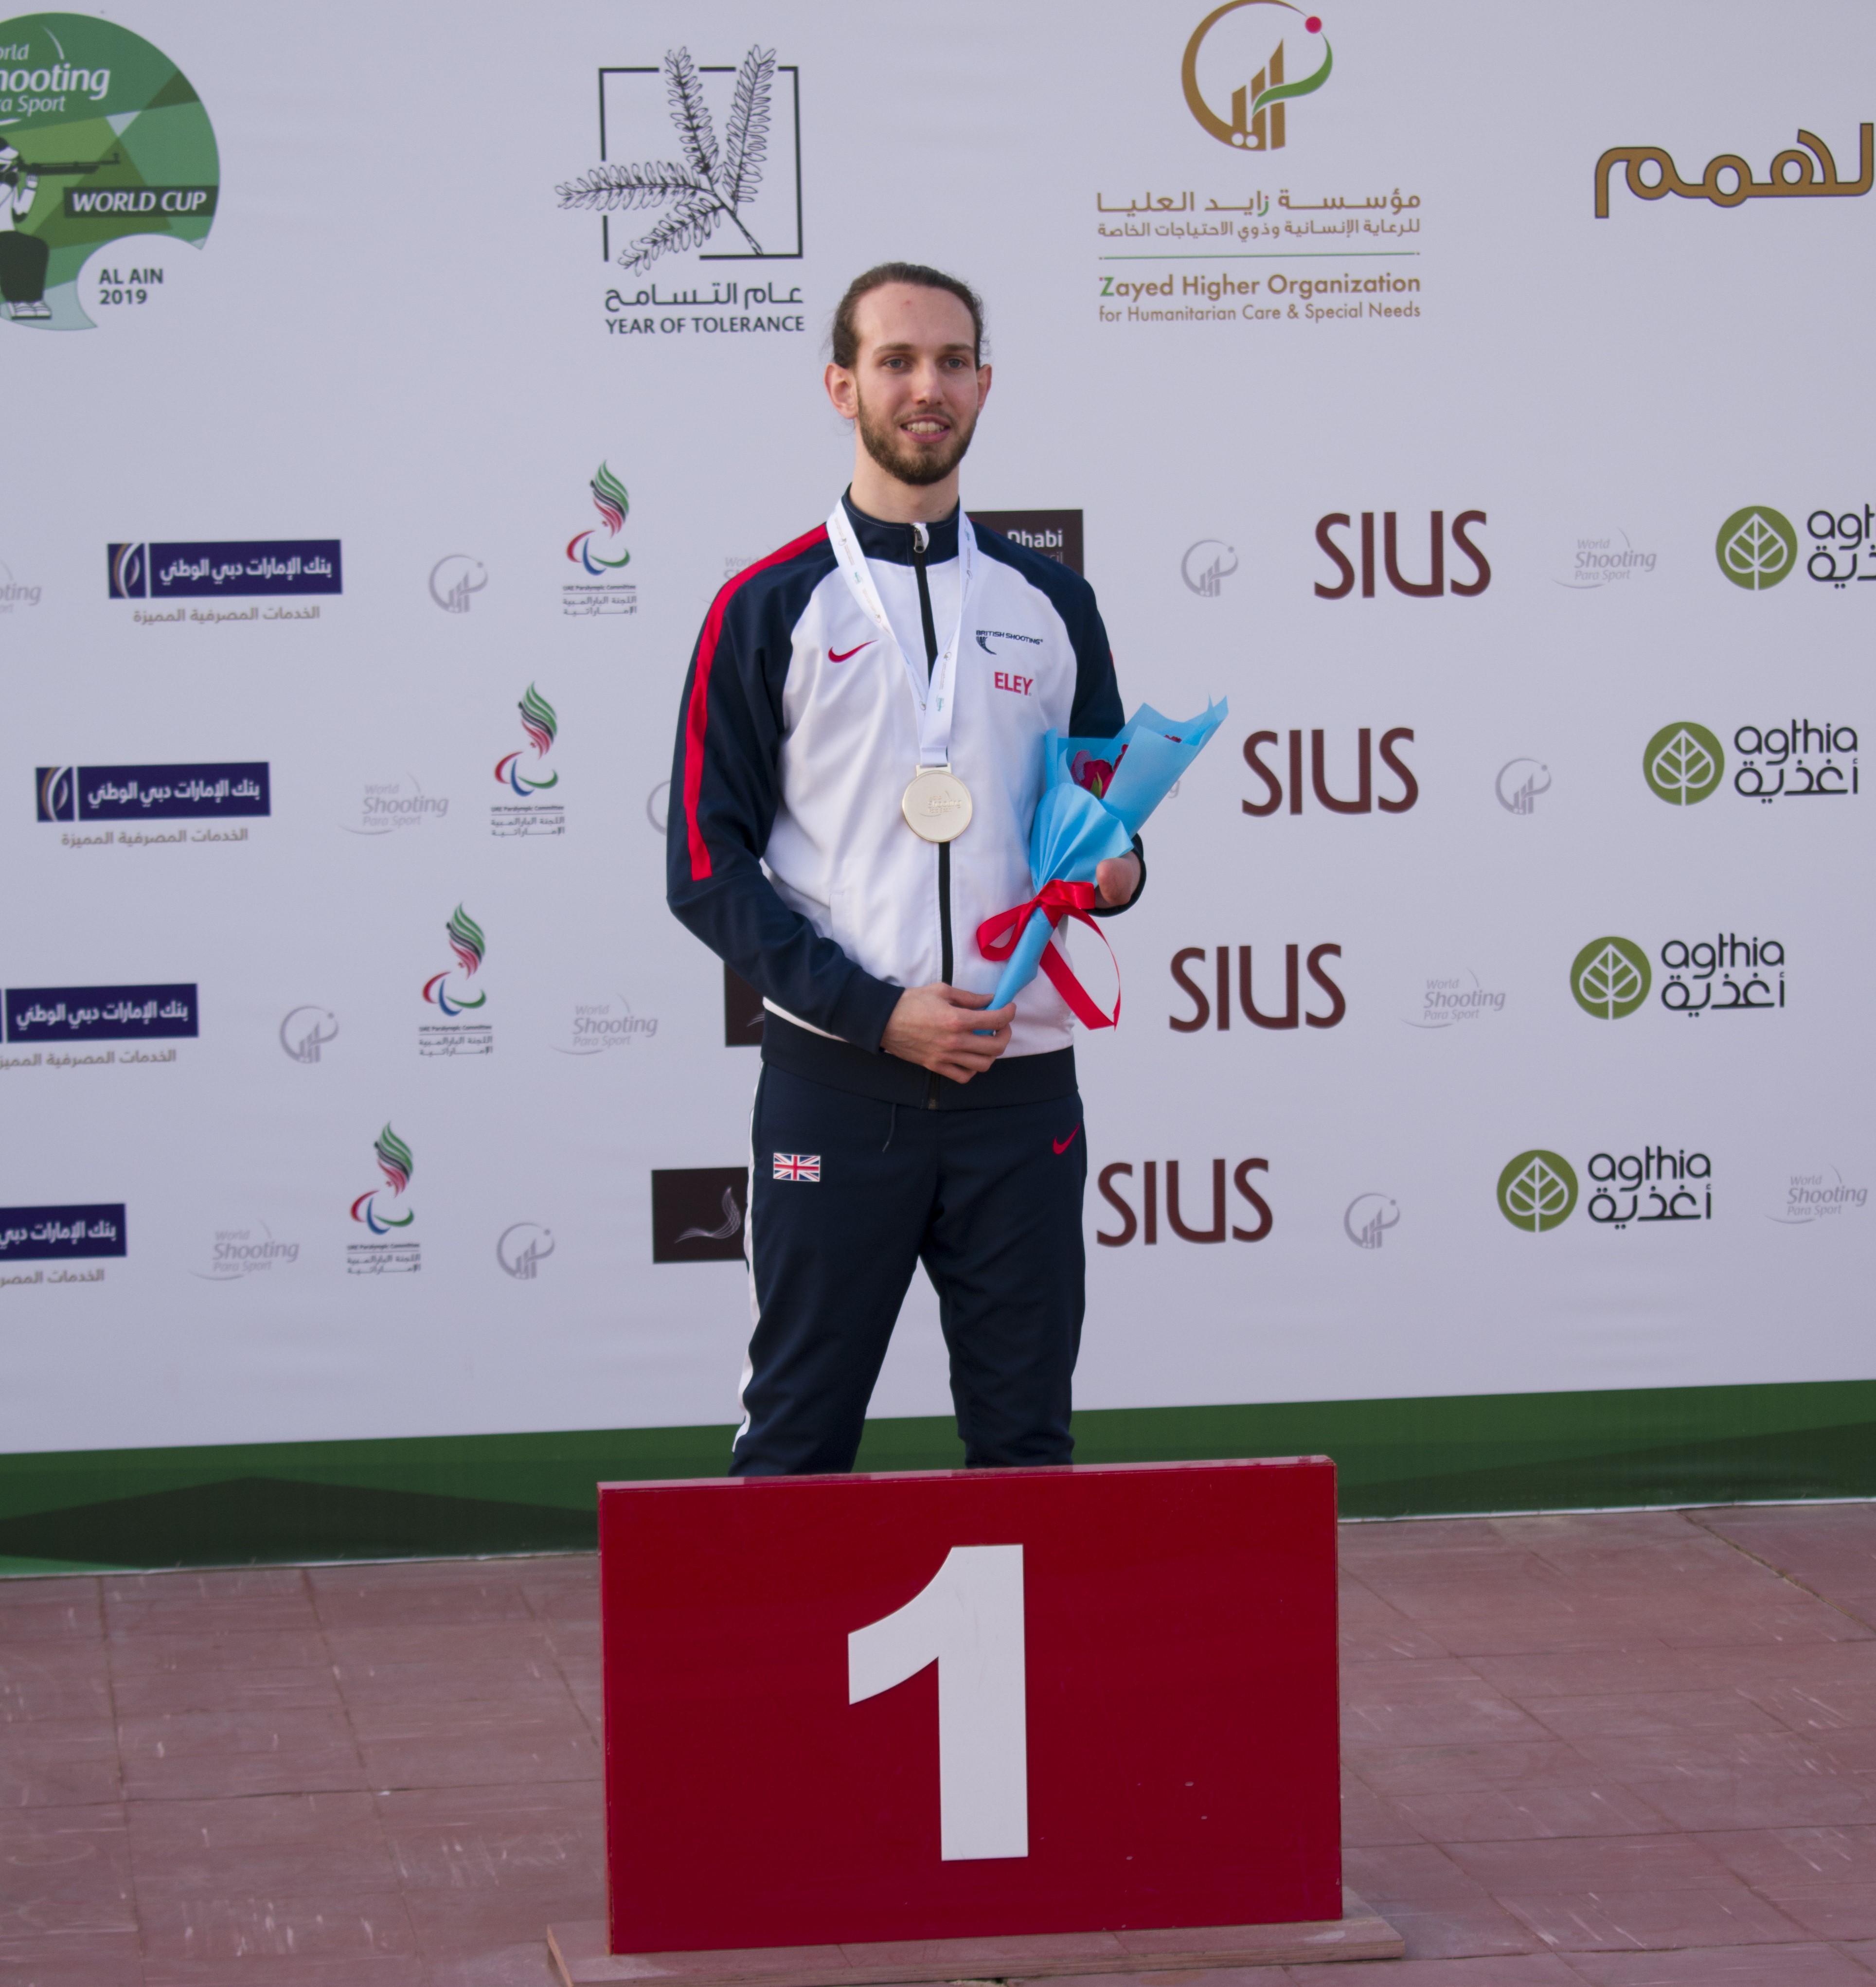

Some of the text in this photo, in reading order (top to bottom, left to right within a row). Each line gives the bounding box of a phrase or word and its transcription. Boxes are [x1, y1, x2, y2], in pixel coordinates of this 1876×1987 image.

[17, 94, 66, 117] Sport
[72, 191, 207, 212] WORLD CUP
[1097, 188, 1421, 217] مؤسسة زايد العليا
[1098, 218, 1420, 242] للرعاية الإنسانية وذوي الاحتياجات الخاصة
[99, 268, 164, 285] AL AIN
[1099, 272, 1421, 303] Zayed Higher Organization
[99, 289, 147, 305] 2019
[605, 282, 804, 313] عام التسامح
[1099, 301, 1421, 323] for Humanitarian Care & Special Needs
[606, 316, 805, 334] YEAR OF TOLERANCE
[1807, 503, 1876, 551] agt
[1314, 510, 1491, 600] SIUS
[1577, 538, 1609, 550] World
[160, 555, 332, 586] بنك الإمارات دبي الوطني
[1574, 550, 1657, 572] Shooting
[1574, 569, 1630, 582] Para Sport
[133, 606, 320, 626] الخدمات المصرفية المميزة
[995, 671, 1034, 696] ELEY
[1734, 718, 1858, 766] agthia
[1242, 727, 1419, 817] SIUS
[1734, 758, 1858, 805] أغذية
[88, 778, 260, 808] بنك الإمارات دبي الوطني
[364, 784, 399, 795] World
[362, 796, 449, 818] Shooting
[362, 815, 421, 828] Para Sport
[61, 828, 248, 848] الخدمات المصرفية المميزة
[1661, 933, 1784, 980] agthia
[1169, 943, 1346, 1034] SIUS
[1427, 979, 1459, 990] World
[1662, 971, 1785, 1018] أغذية
[575, 1004, 609, 1015] World
[1423, 990, 1506, 1012] Shooting
[16, 1000, 188, 1031] بنك الإمارات دبي الوطني
[1424, 1008, 1479, 1021] Para Sport
[572, 1016, 658, 1038] Shooting
[47, 1051, 115, 1069] المصرفية
[119, 1049, 177, 1064] الخدمات
[1588, 1146, 1711, 1193] agthia
[1790, 1175, 1822, 1185] World
[1097, 1158, 1273, 1248] SIUS
[1588, 1184, 1712, 1230] أغذية
[1787, 1186, 1868, 1207] Shooting
[1787, 1204, 1842, 1217] Para Sport
[30, 1220, 85, 1245] الإمارات
[88, 1219, 116, 1241] بنك
[213, 1242, 300, 1263] Shooting
[48, 1268, 104, 1283] الخدمات
[848, 1544, 1029, 1862] 1
